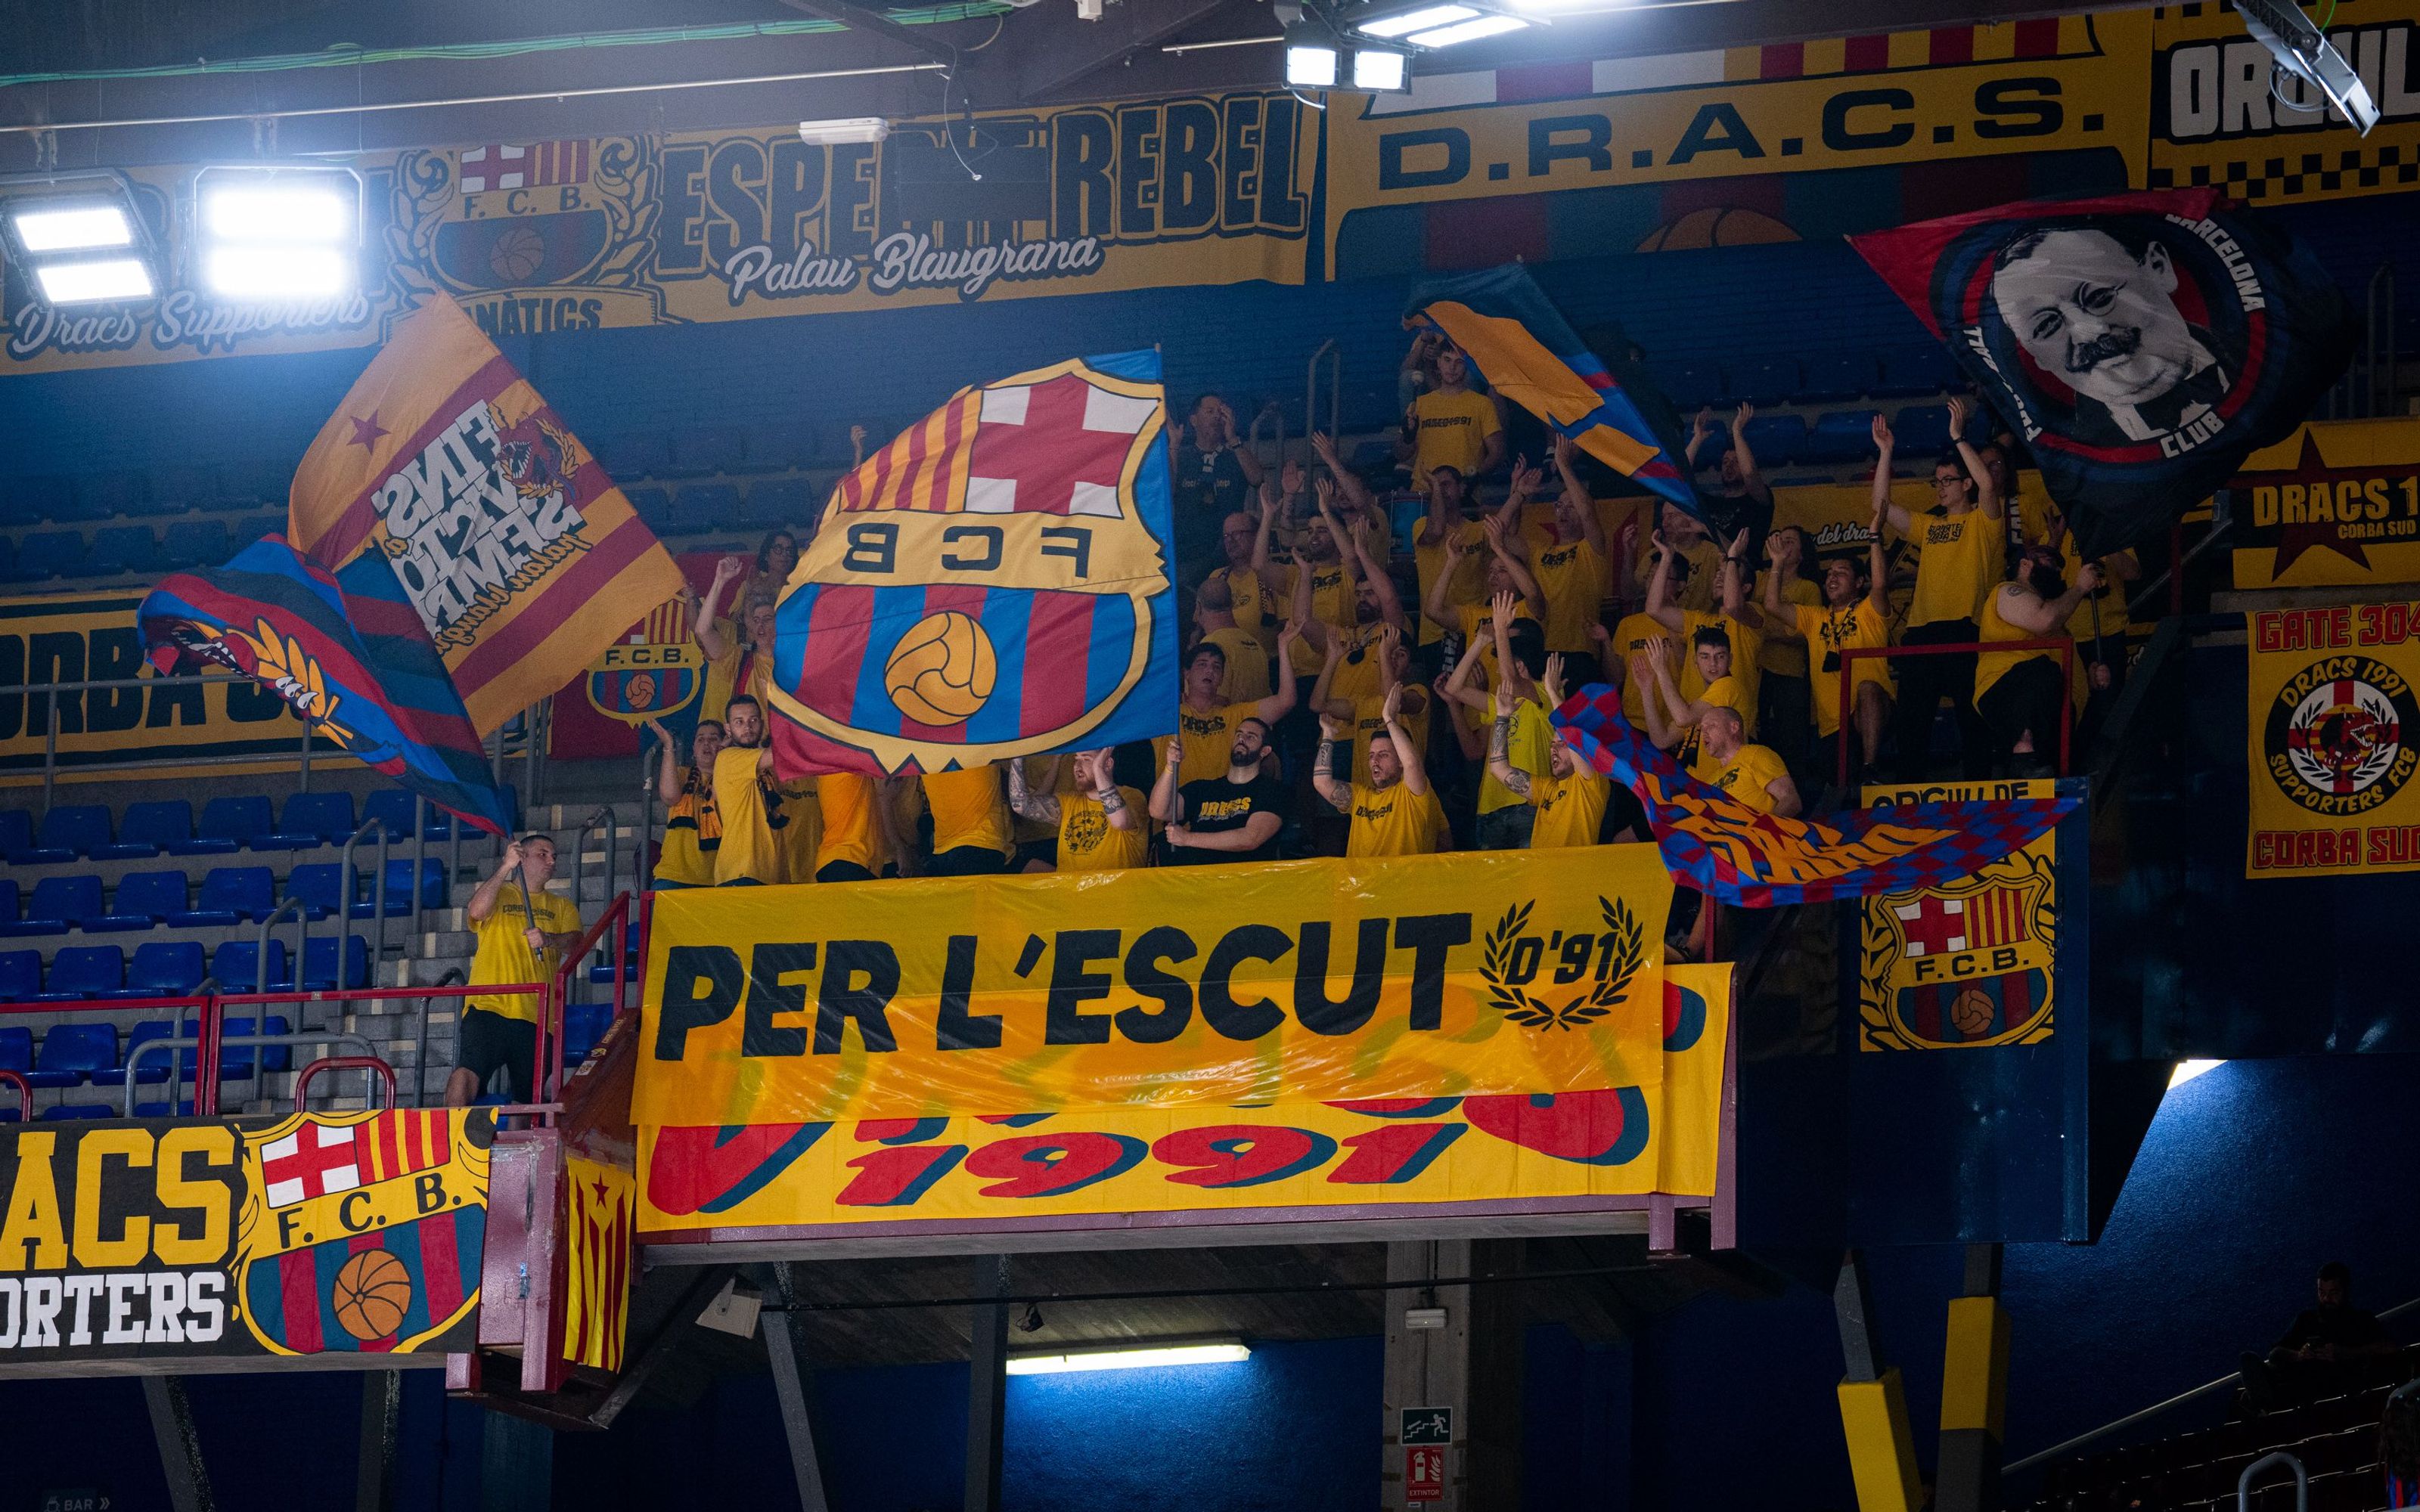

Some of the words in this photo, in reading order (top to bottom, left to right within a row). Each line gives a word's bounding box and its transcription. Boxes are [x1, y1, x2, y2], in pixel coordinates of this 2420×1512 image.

[1379, 77, 2105, 191] D.R.A.C.S.
[655, 117, 1047, 276] ESPE
[1050, 91, 1308, 245] REBEL
[725, 241, 855, 299] Palau
[873, 232, 1100, 295] Blaugrana
[13, 301, 137, 353] Dracs
[462, 292, 603, 336] NÀTICS
[2160, 411, 2226, 458] CLUB
[2253, 479, 2390, 527] DRACS
[1843, 521, 1870, 542] dra
[2337, 523, 2384, 540] CORBA
[2387, 519, 2417, 537] SUD
[2256, 606, 2351, 653] GATE
[2280, 656, 2358, 708] DRACS
[2362, 661, 2408, 699] 1991
[2270, 753, 2385, 814] SUPPORTERS
[2387, 746, 2418, 788] FCB
[2253, 829, 2361, 869] CORBA
[656, 940, 901, 1062] PER
[936, 912, 1472, 1051] L'ESCUT
[835, 1123, 1469, 1207] 1991
[0, 1126, 235, 1271] ACS
[64, 1498, 93, 1511] BAR
